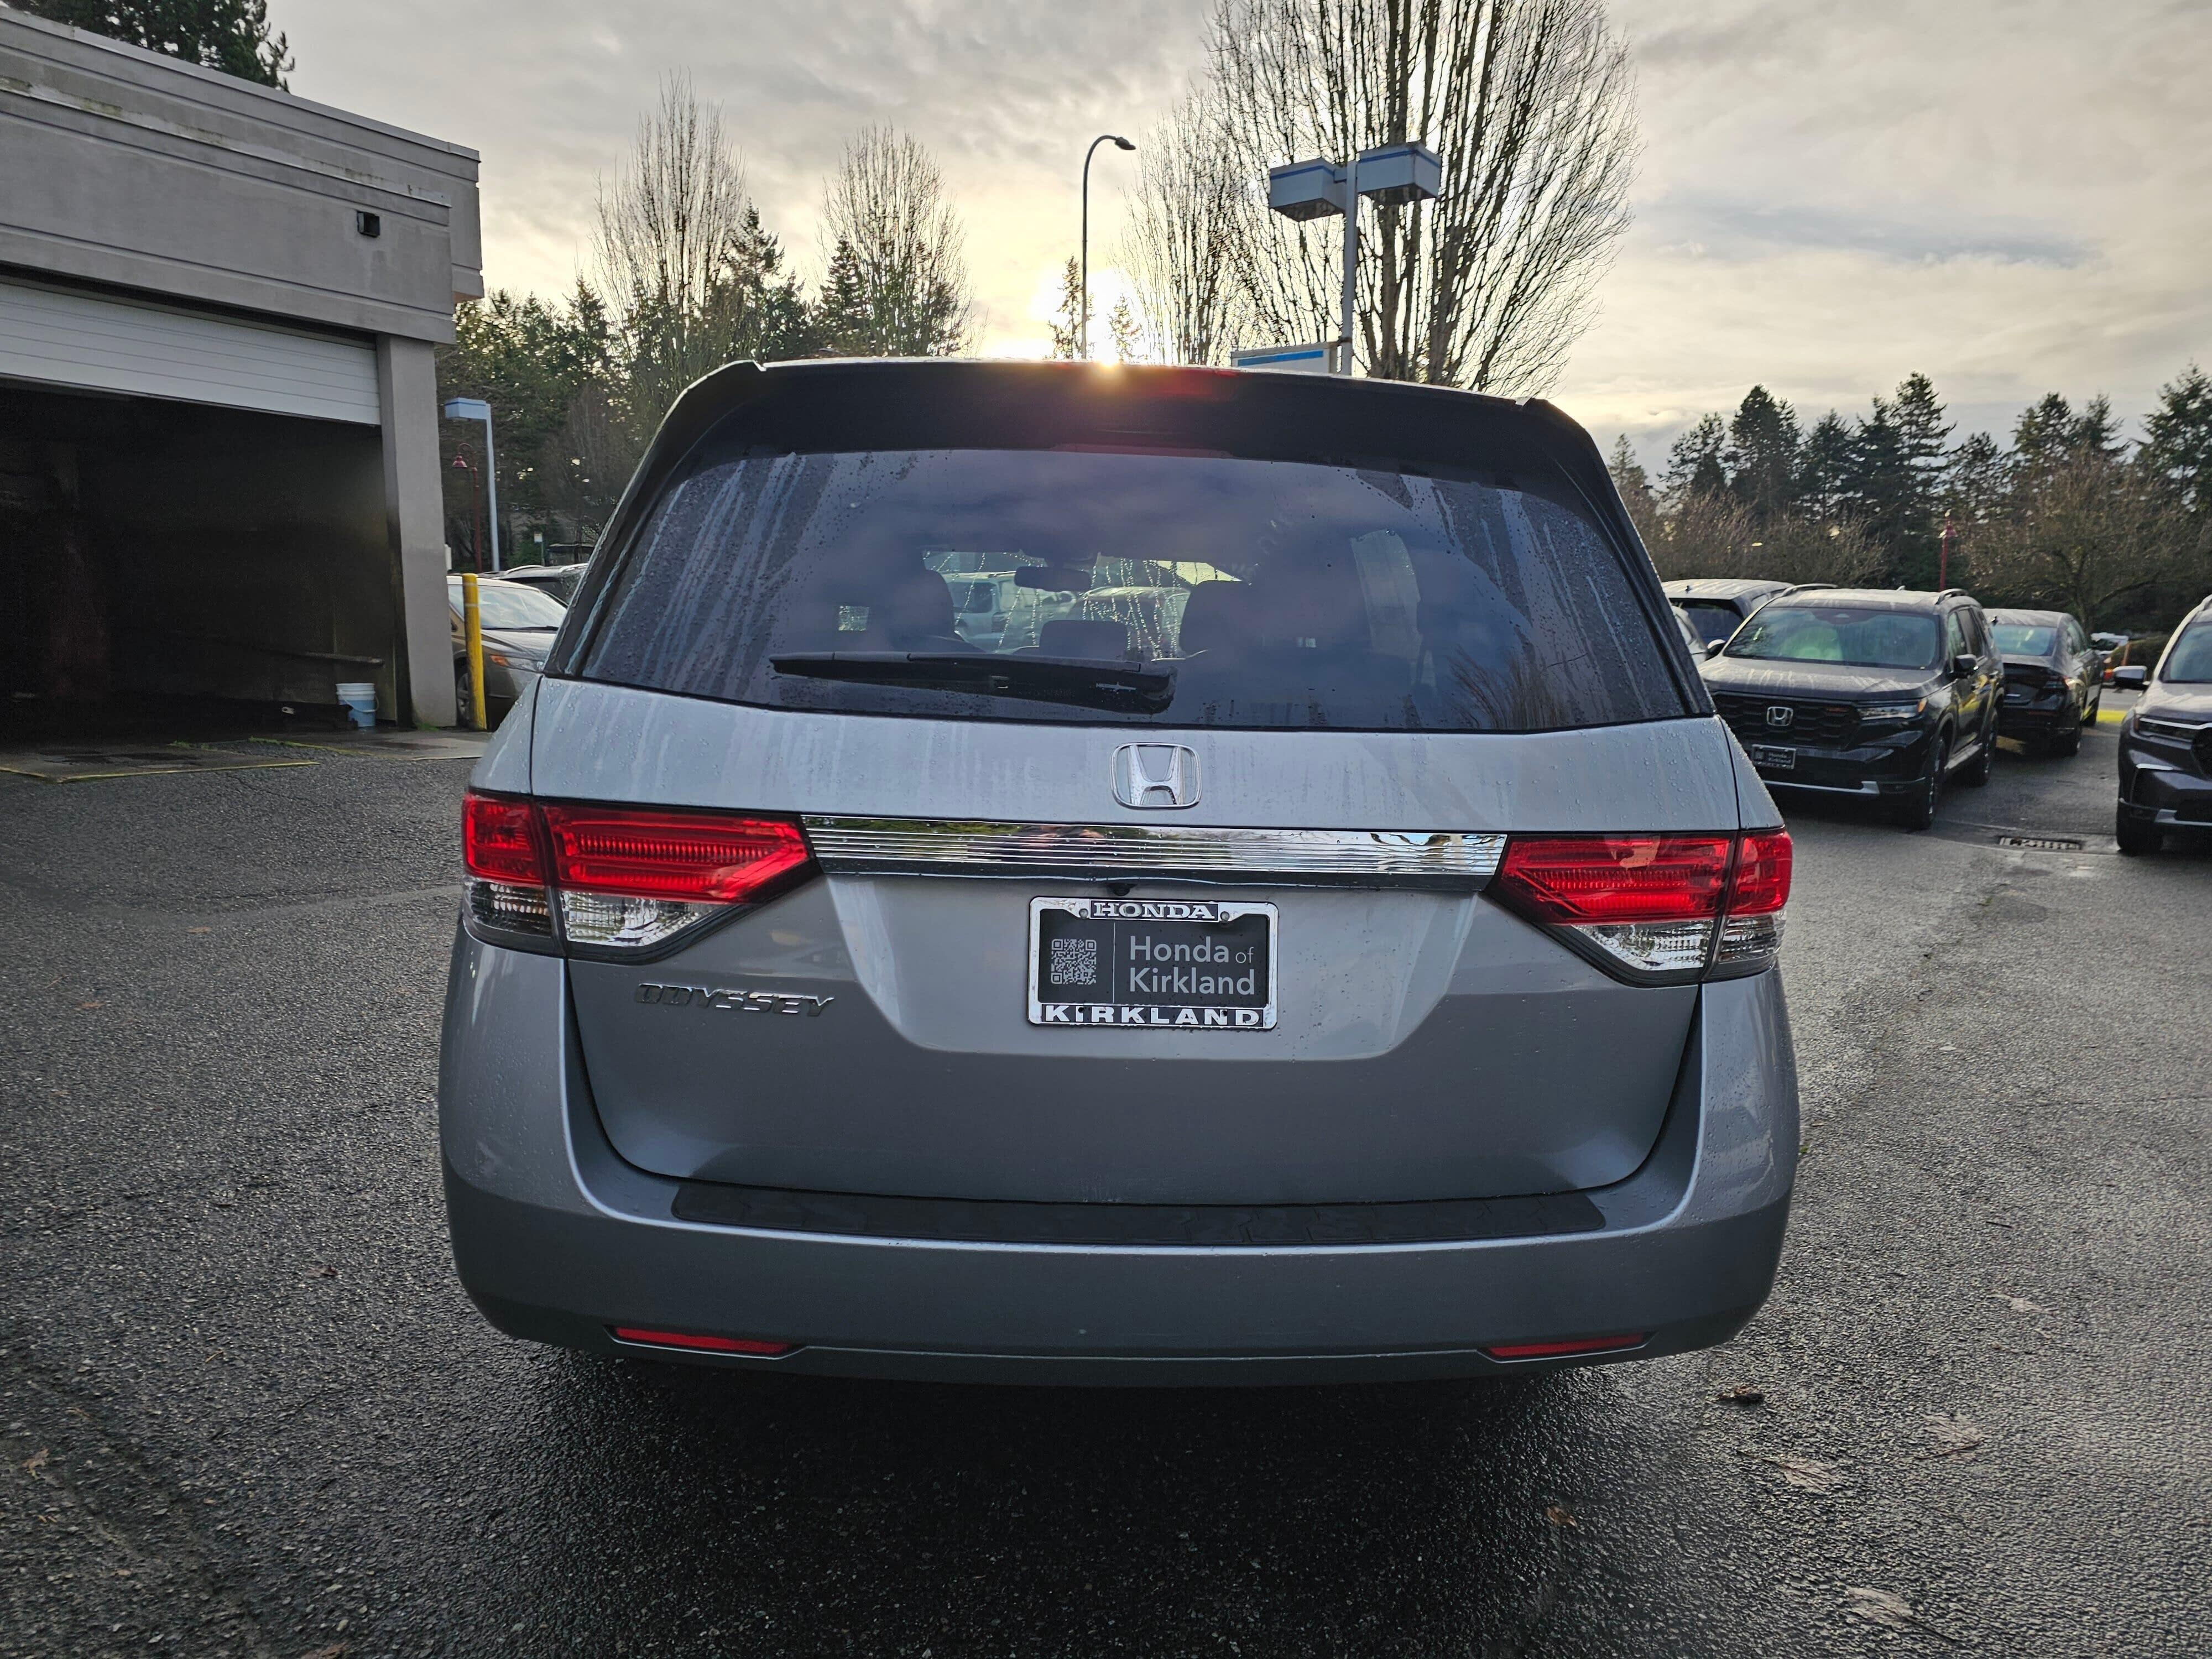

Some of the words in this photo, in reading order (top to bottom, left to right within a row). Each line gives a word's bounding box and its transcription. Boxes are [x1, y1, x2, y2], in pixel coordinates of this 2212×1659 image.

[1093, 901, 1214, 919] HONDA
[1130, 936, 1229, 963] Honda
[1235, 947, 1254, 963] of
[1130, 967, 1254, 995] Kirkland
[635, 983, 834, 1017] ODYSSEY
[1045, 1005, 1260, 1026] KIRKLAND
